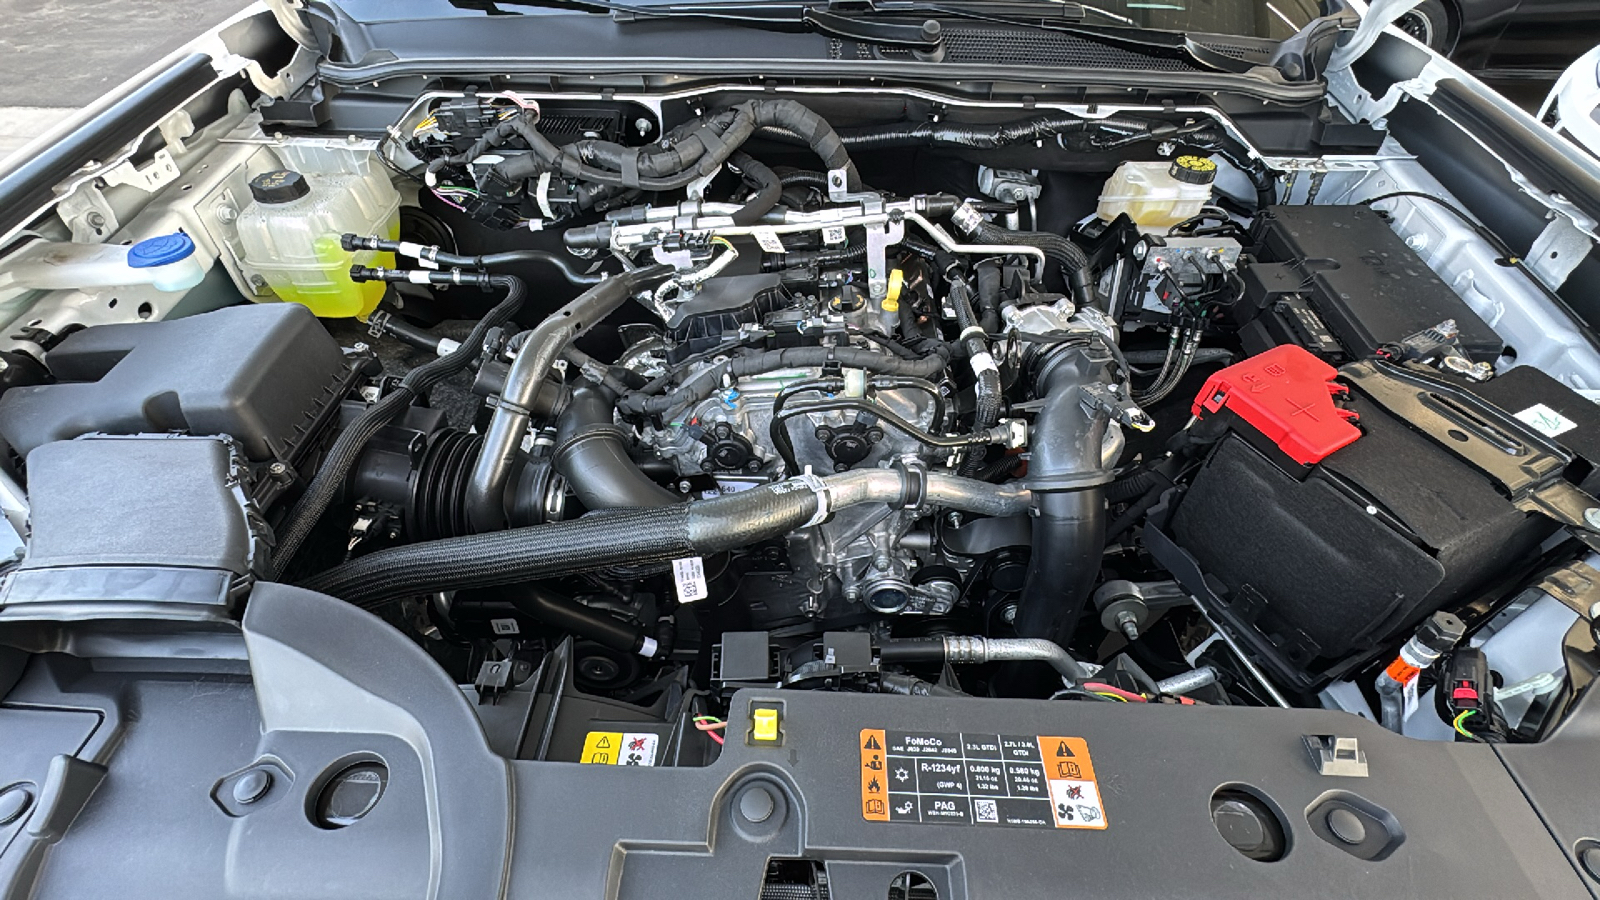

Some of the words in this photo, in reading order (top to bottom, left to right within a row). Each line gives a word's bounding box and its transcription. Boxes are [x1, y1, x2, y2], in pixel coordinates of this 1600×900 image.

[905, 736, 942, 746] FoMoCo
[921, 763, 961, 775] R-1234yf
[934, 801, 956, 811] PAG
